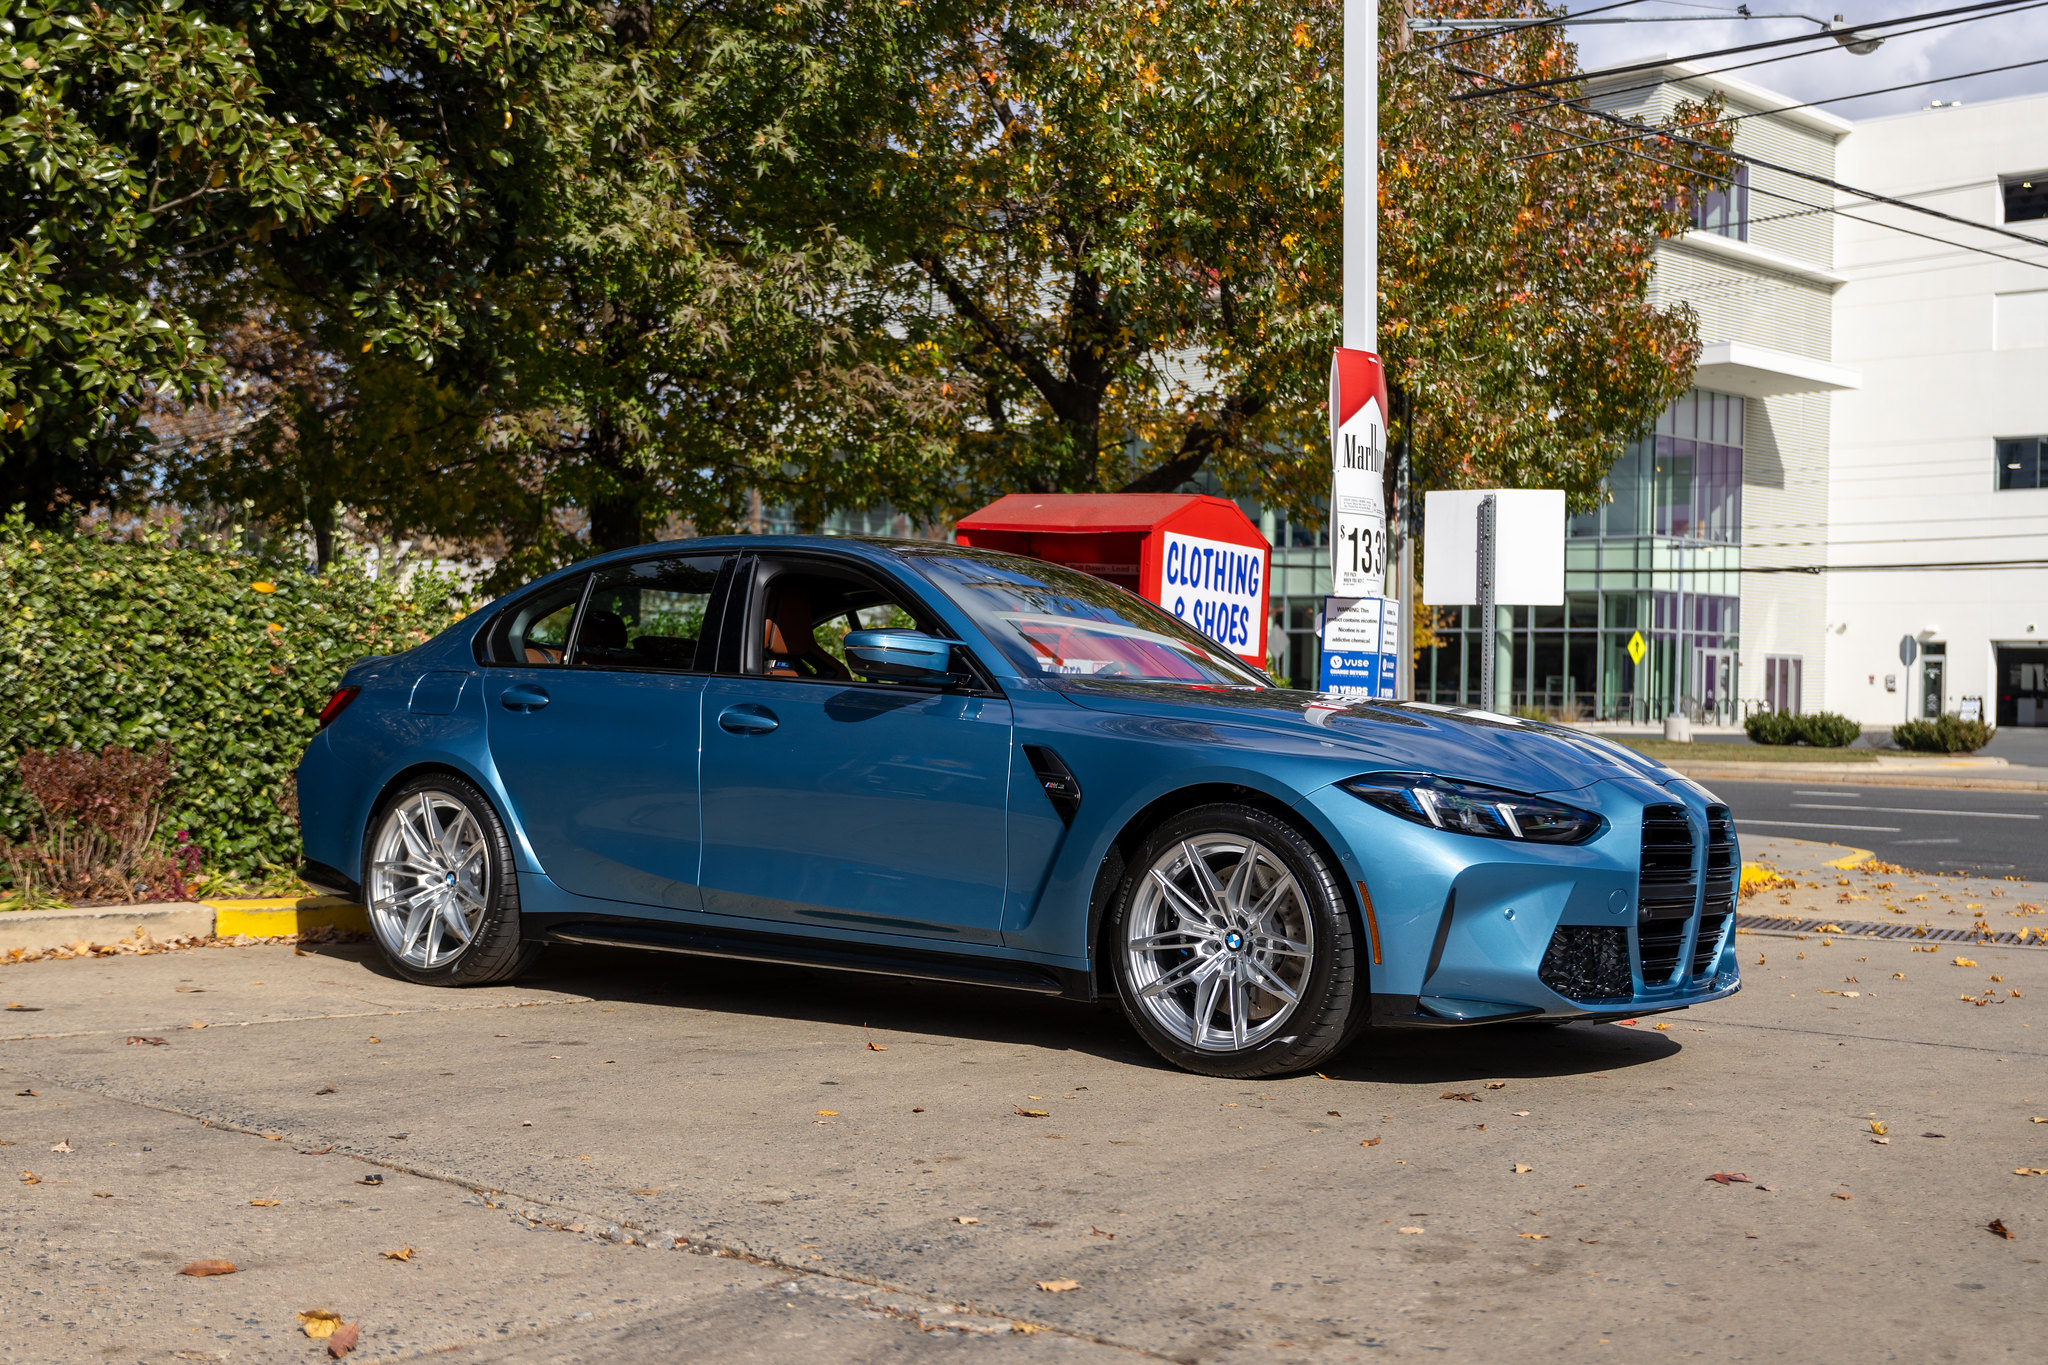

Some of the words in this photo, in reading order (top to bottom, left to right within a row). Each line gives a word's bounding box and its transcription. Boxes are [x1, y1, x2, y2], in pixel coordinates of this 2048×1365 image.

[1340, 524, 1345, 539] $
[1167, 541, 1260, 597] CLOTHING
[1193, 599, 1249, 647] SHOES
[1328, 684, 1339, 694] 10
[1339, 685, 1369, 696] YEARS
